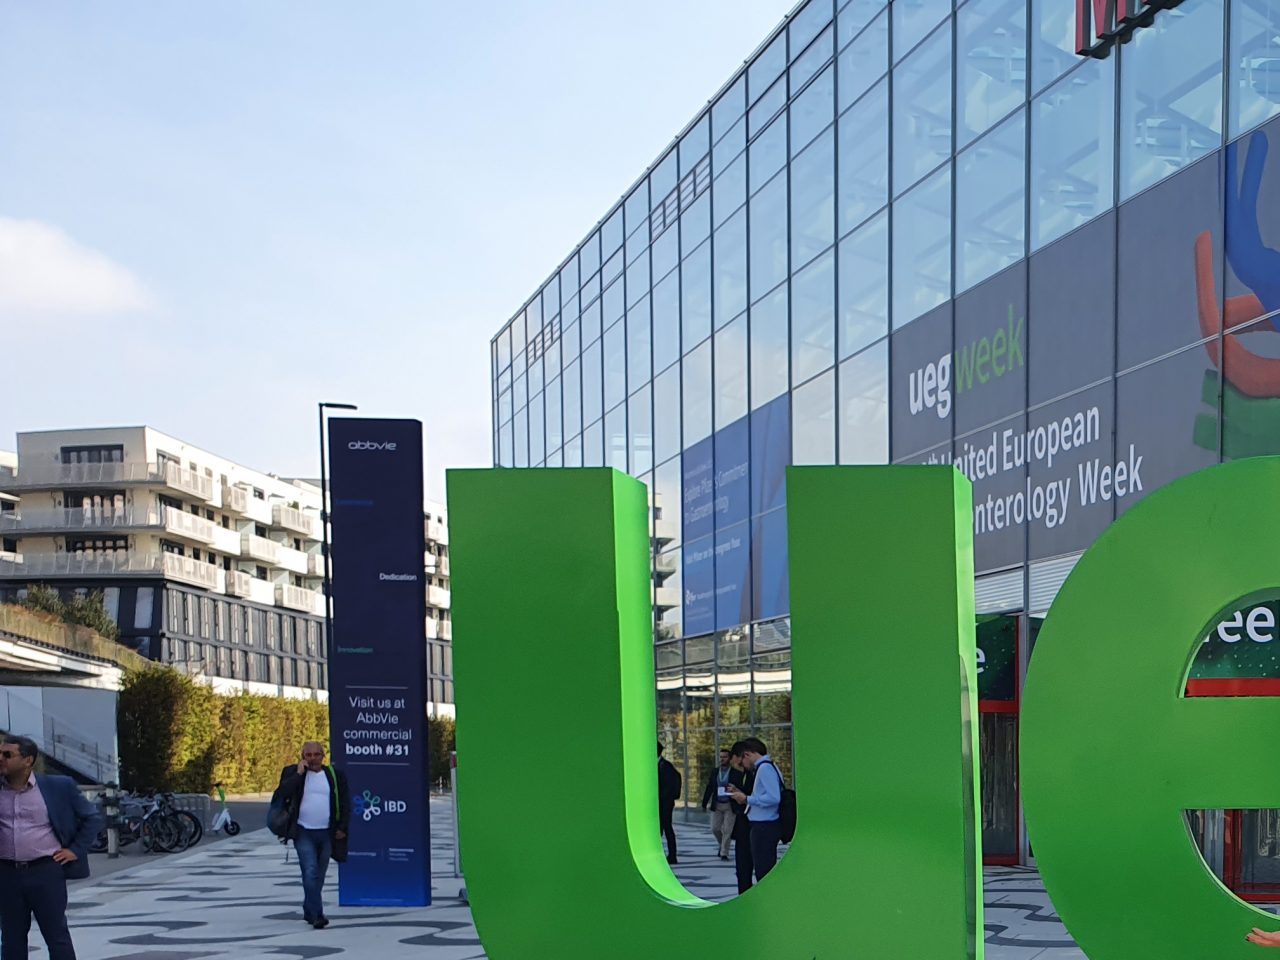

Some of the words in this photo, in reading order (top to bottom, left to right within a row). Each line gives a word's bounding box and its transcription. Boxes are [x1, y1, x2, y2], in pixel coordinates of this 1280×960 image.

[908, 353, 952, 419] ueg
[955, 303, 1025, 394] week
[1002, 406, 1100, 471] European
[348, 440, 397, 450] abbvie
[975, 476, 1071, 535] nterology
[1078, 443, 1144, 507] Week
[349, 696, 375, 708] Visit
[377, 698, 391, 708] us
[393, 698, 405, 708] at
[356, 712, 399, 724] AbbVie
[343, 729, 412, 740] commercial
[345, 744, 383, 755] booth
[385, 744, 409, 756] #31
[384, 800, 407, 813] IBD
